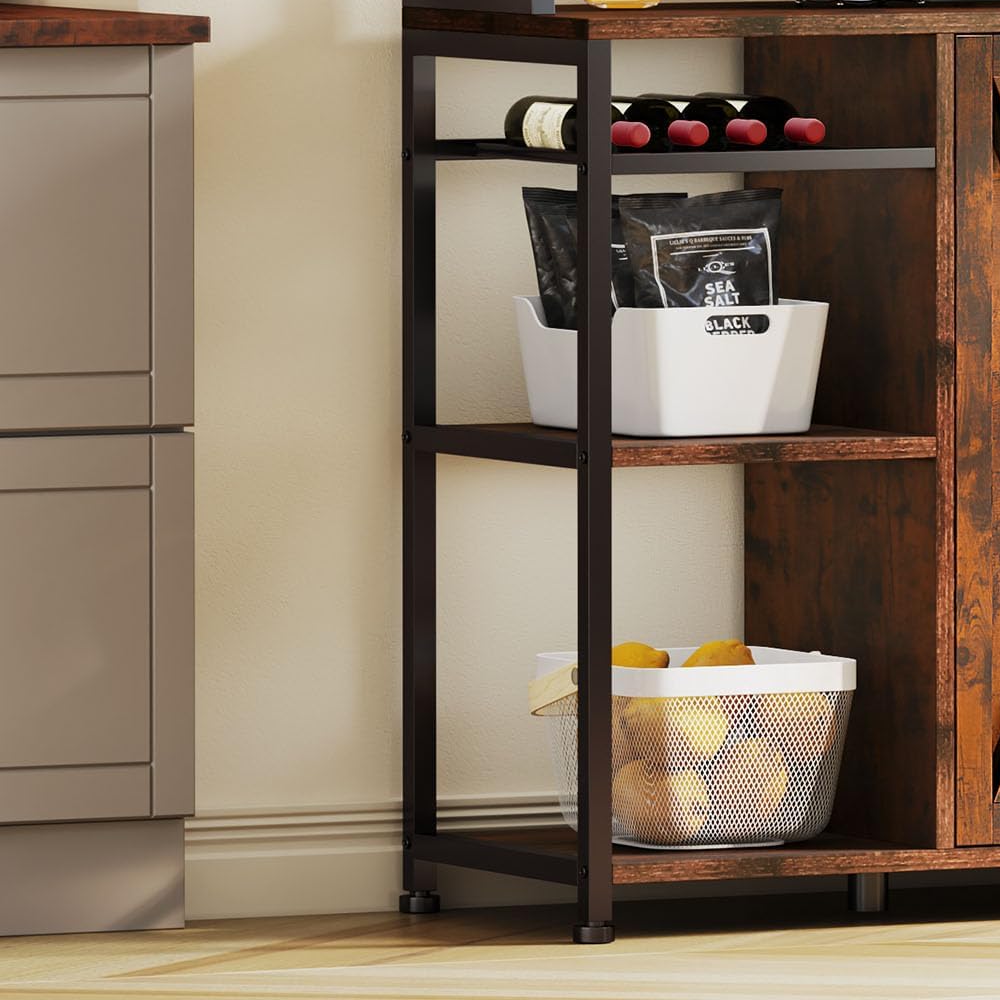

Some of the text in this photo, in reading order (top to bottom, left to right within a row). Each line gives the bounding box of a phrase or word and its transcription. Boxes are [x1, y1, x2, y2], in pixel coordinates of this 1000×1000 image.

[705, 280, 735, 295] SEA
[704, 292, 740, 307] SALT
[705, 316, 751, 331] BLACK
